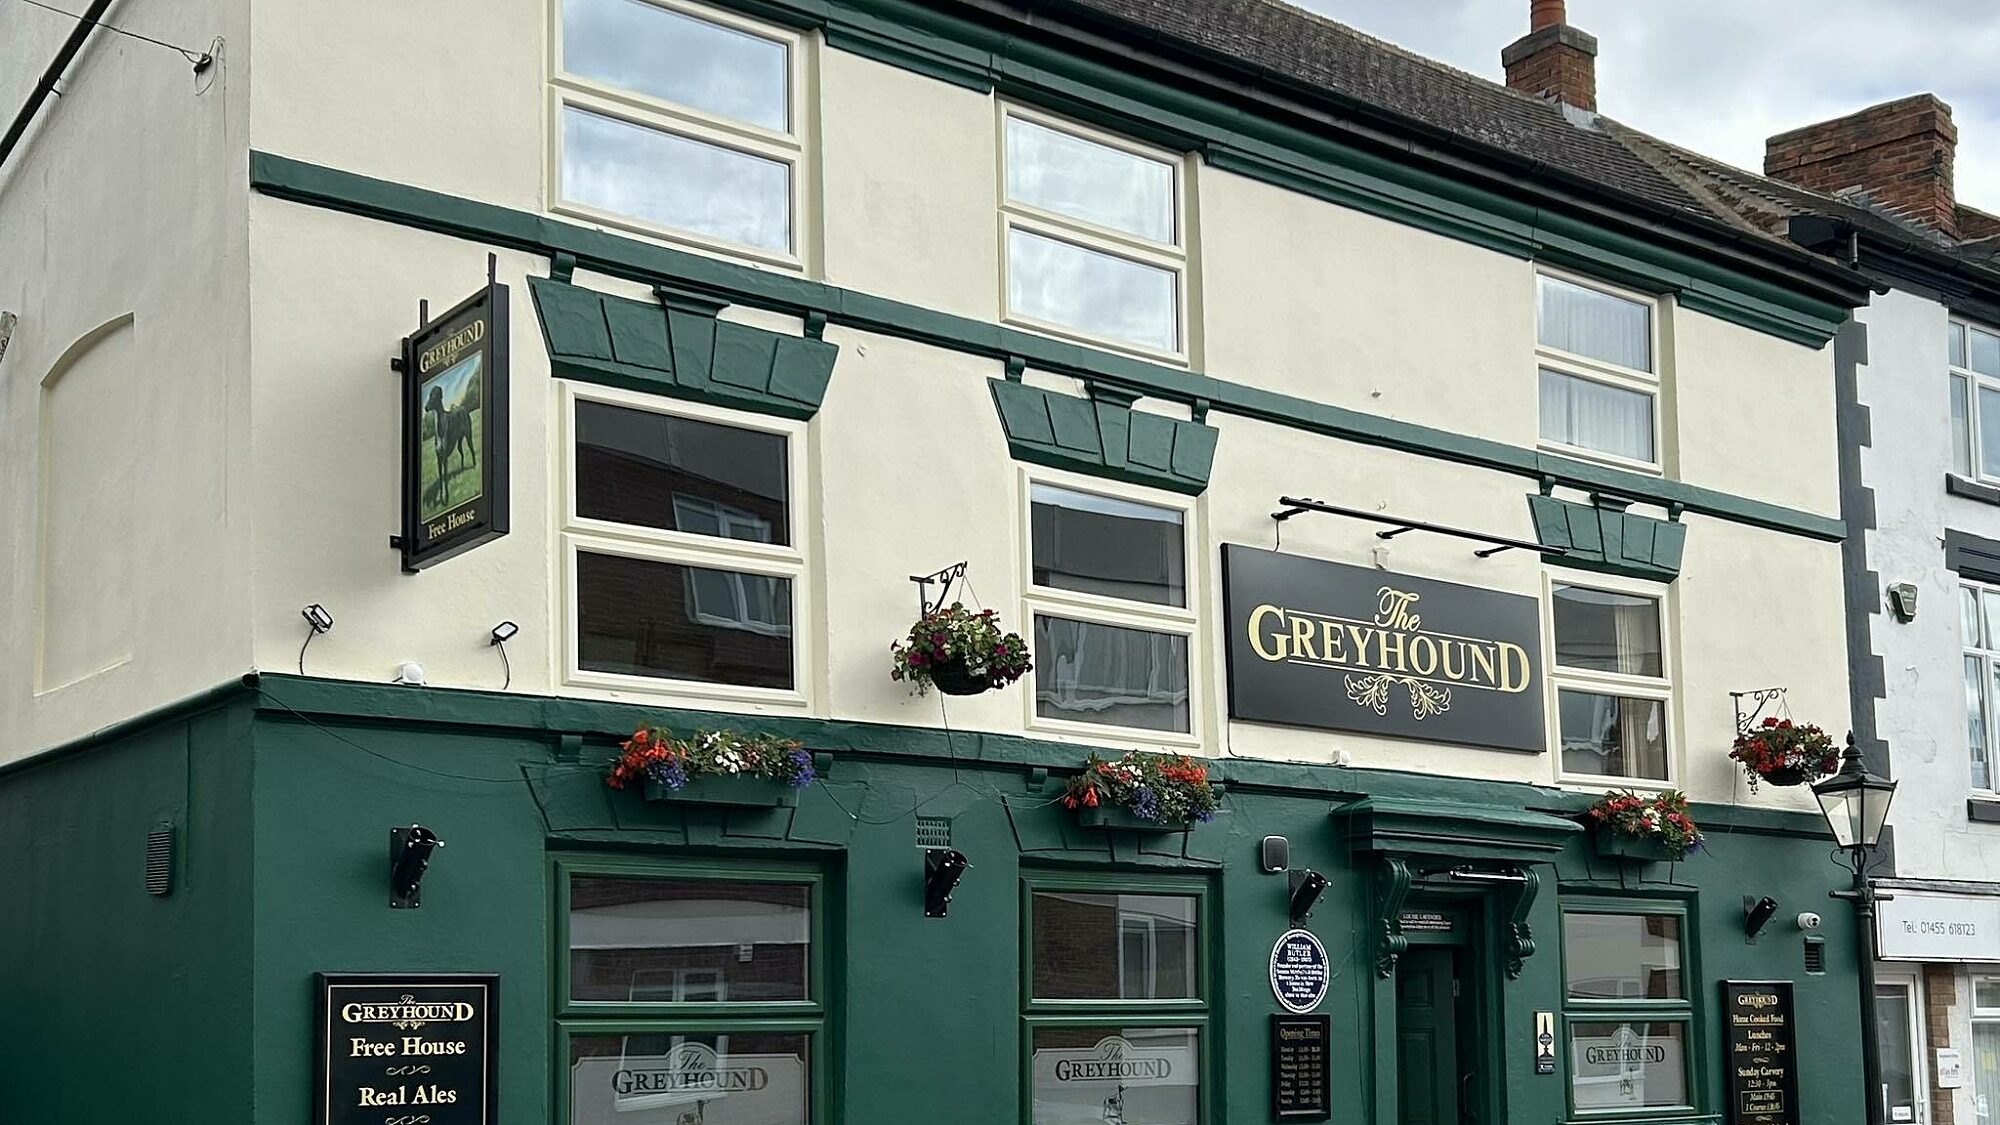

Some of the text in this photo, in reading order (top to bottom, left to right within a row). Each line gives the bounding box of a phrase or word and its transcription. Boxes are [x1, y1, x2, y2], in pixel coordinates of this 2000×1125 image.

[420, 320, 484, 372] GREYHOUND
[428, 507, 475, 540] Free House
[1374, 586, 1420, 631] The
[1248, 604, 1531, 693] GREYHOUND
[1921, 921, 1945, 934] 01455
[1949, 922, 1975, 936] 618123
[401, 994, 416, 1005] The
[342, 1002, 475, 1023] GREYHOUND
[1732, 1013, 1784, 1023] Home Cooked Food
[1280, 1027, 1304, 1040] Opening
[1748, 1029, 1772, 1040] Lunches
[350, 1036, 466, 1057] Free House
[1586, 1046, 1665, 1064] GREYHOUND
[1735, 1042, 1748, 1052] Mon
[1055, 1058, 1172, 1081] GREYHOUND
[1738, 1066, 1784, 1079] Sunday Carvery
[611, 1068, 769, 1095] GREYHOUND
[358, 1085, 457, 1107] Real Ales
